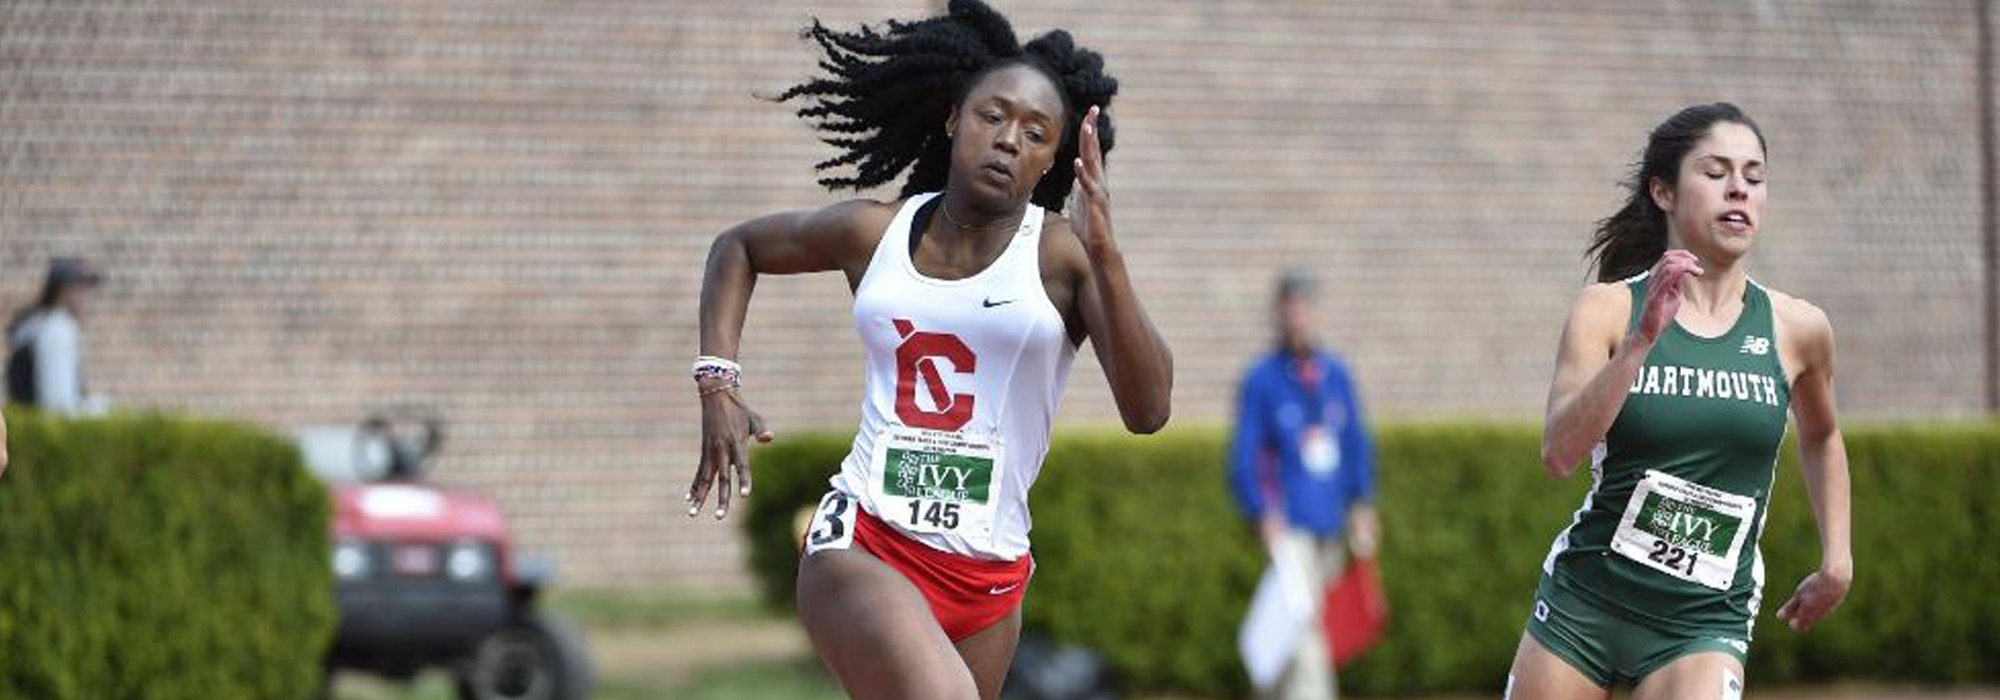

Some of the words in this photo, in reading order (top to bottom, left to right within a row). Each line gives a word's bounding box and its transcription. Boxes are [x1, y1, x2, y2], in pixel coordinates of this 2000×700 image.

[1629, 365, 1779, 407] DARTMOUTH
[917, 464, 973, 490] IVY
[811, 491, 848, 546] 3
[908, 499, 961, 530] 145
[1670, 511, 1721, 541] IVY
[1648, 540, 1698, 576] 221
